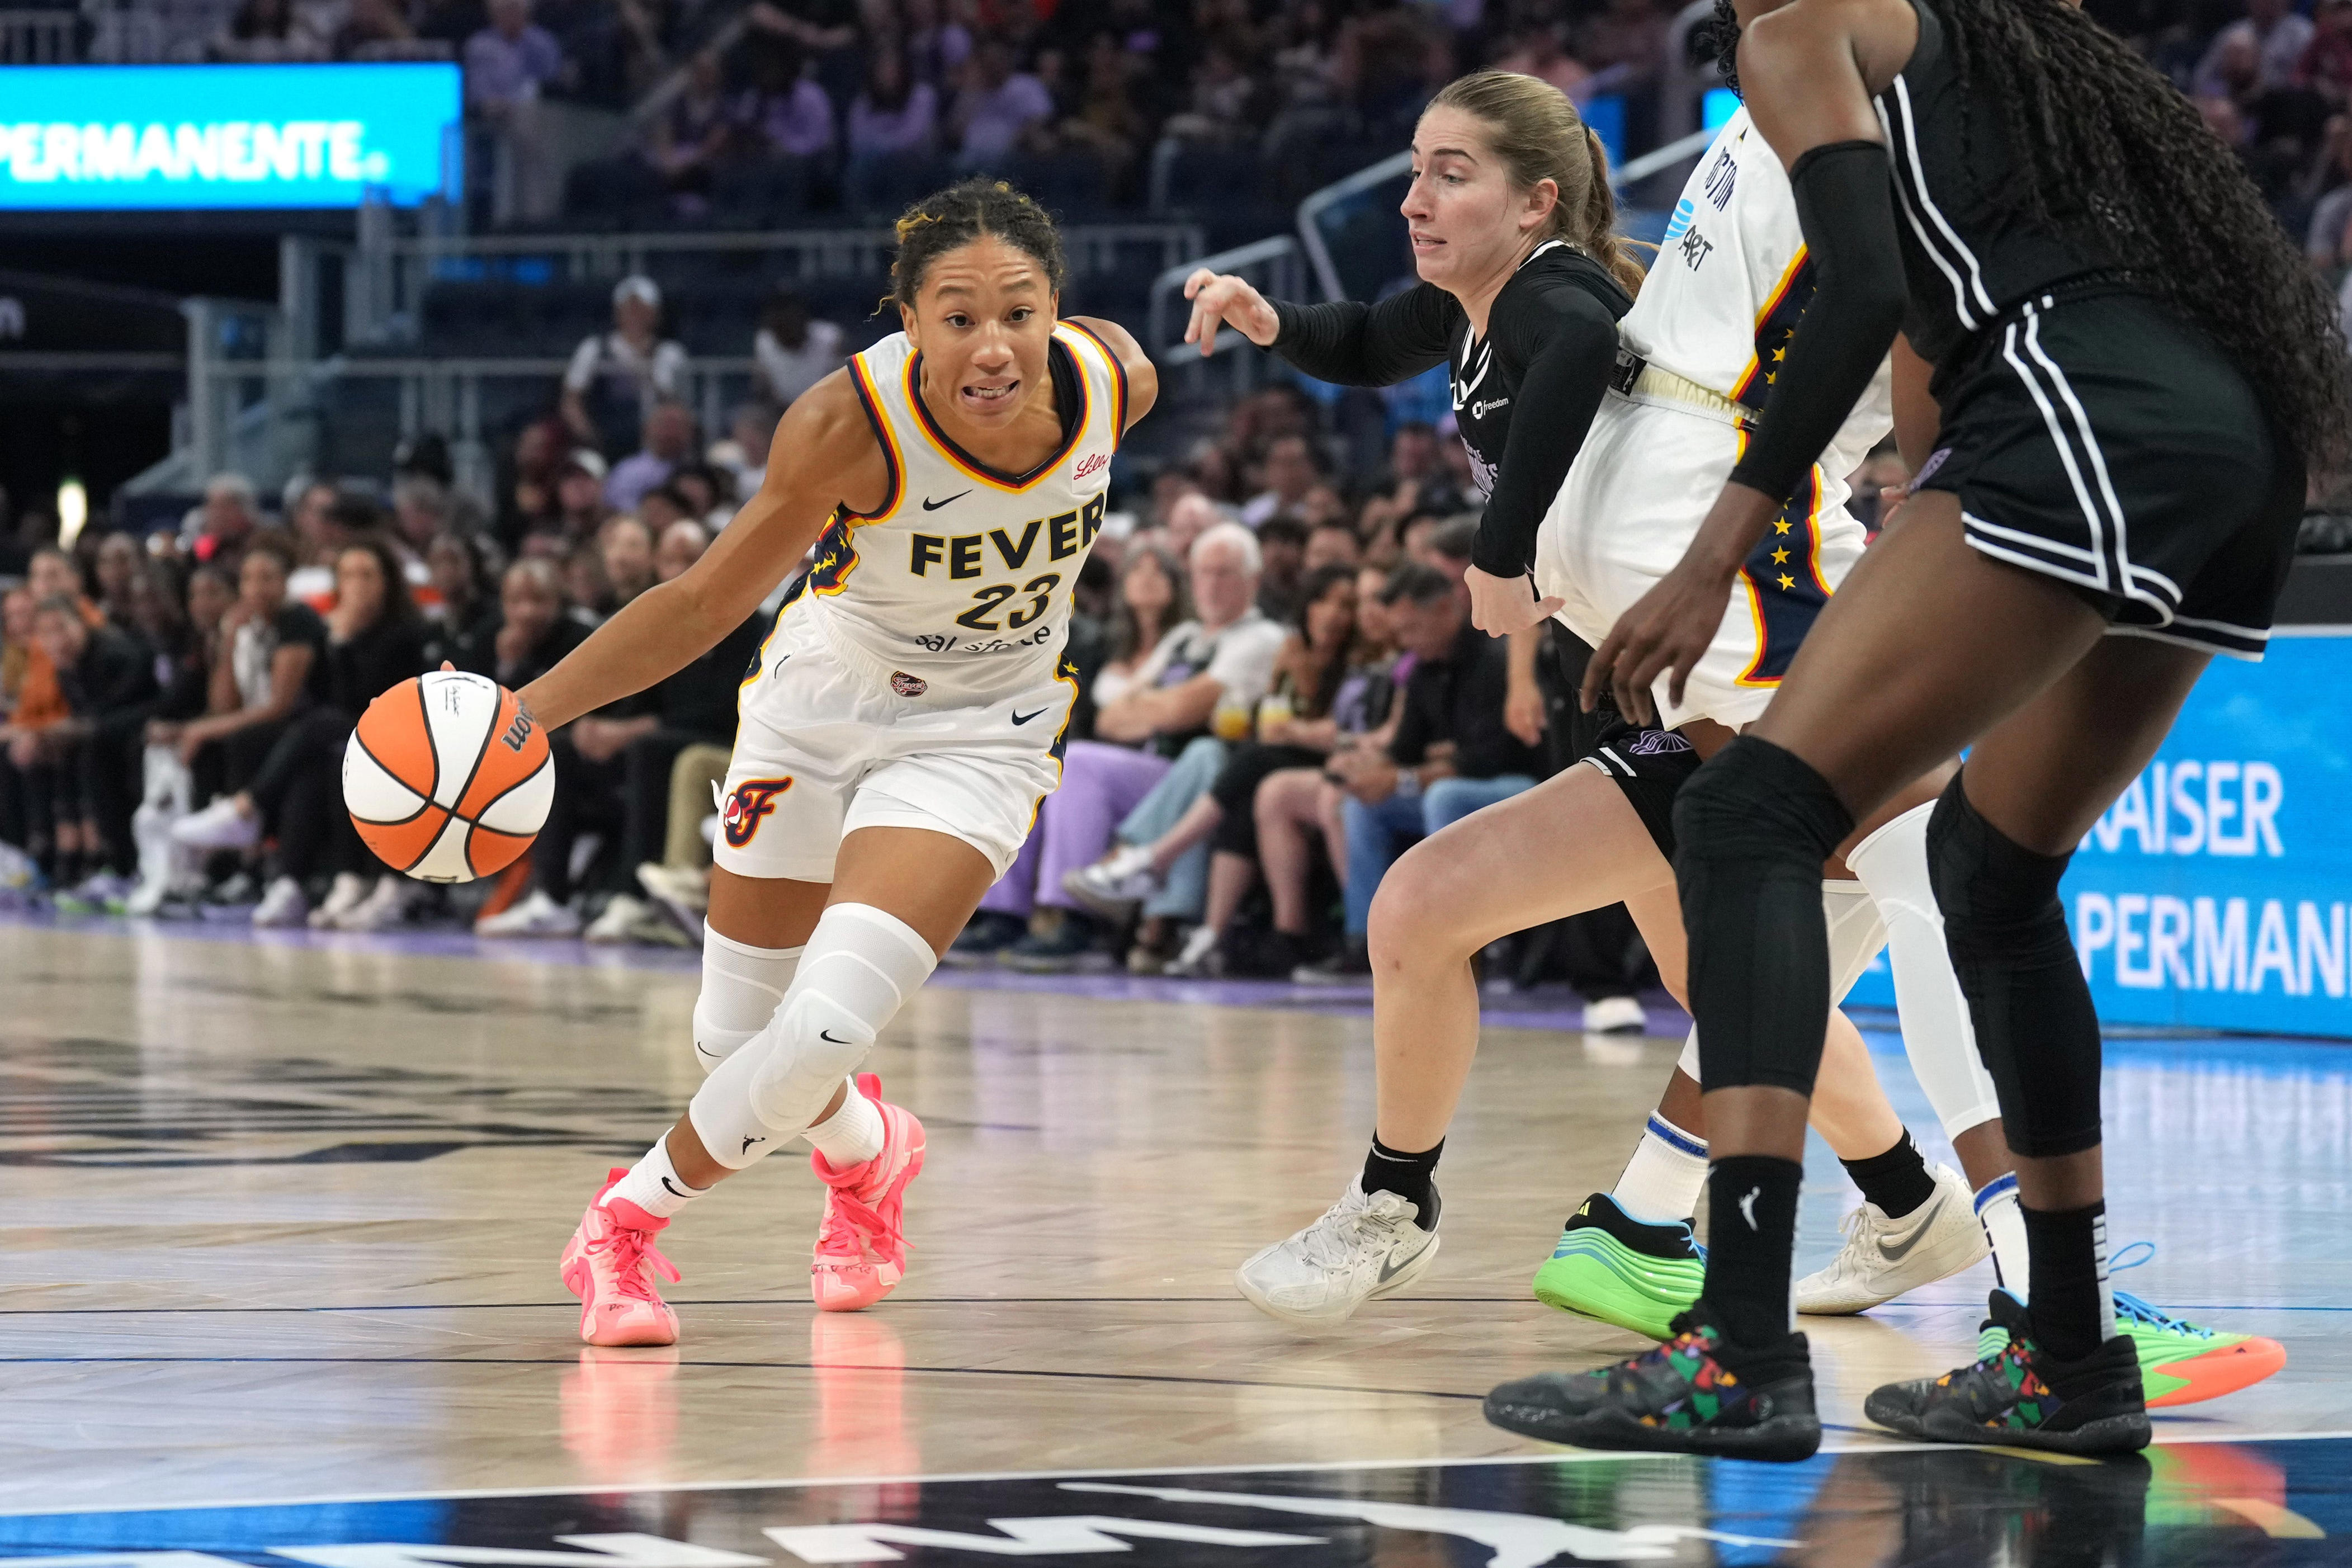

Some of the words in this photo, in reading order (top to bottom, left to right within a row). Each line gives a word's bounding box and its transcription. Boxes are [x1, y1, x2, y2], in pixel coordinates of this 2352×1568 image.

[1483, 397, 1509, 415] freedom
[1073, 454, 1110, 480] Lilly
[909, 490, 1105, 580] FEVER
[955, 572, 1061, 631] 23
[890, 676, 928, 692] Fever
[2076, 761, 2284, 857] AISER
[2075, 892, 2352, 998] PERMAN
